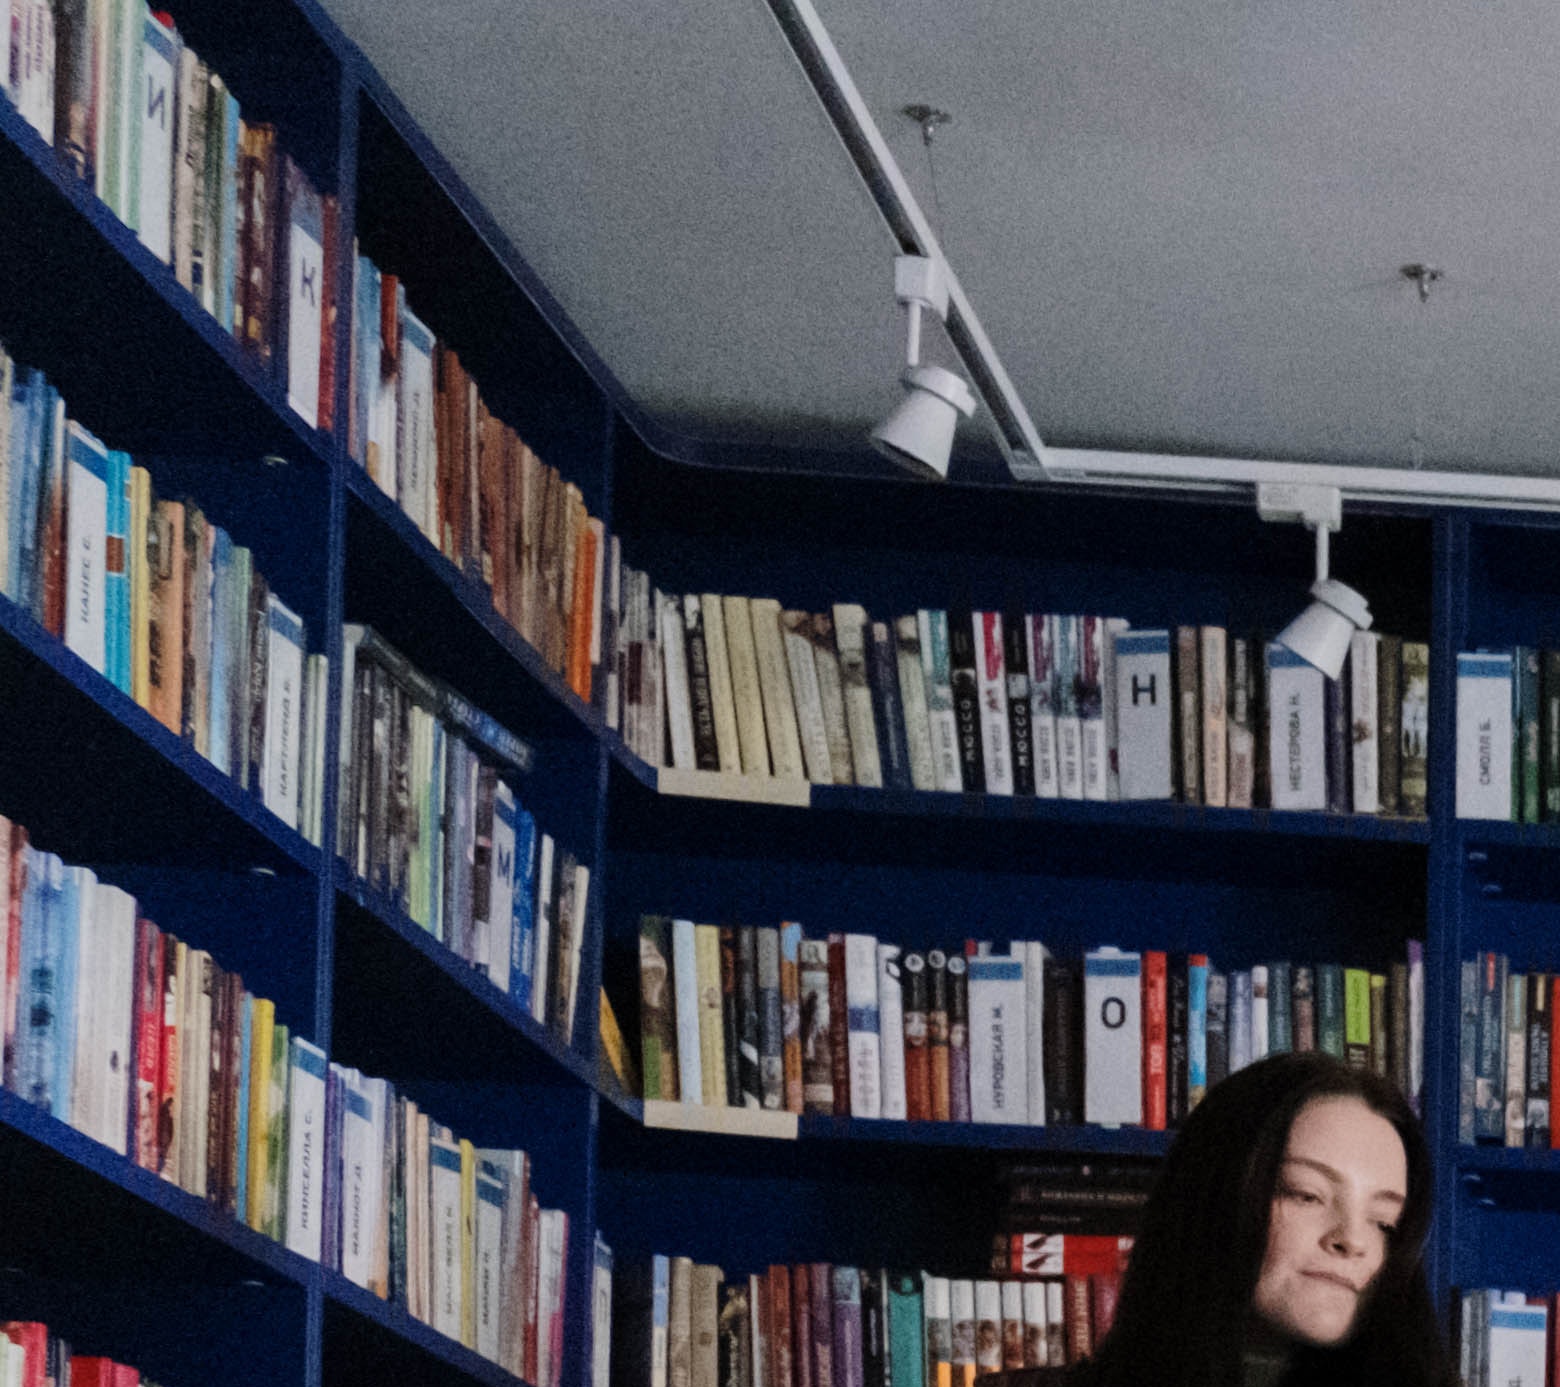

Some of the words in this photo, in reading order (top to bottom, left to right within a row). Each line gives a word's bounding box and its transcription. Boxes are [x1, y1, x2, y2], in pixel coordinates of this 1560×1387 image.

[1131, 675, 1157, 706] Н
[1287, 710, 1302, 792] НЕСТЕРОВА
[1478, 737, 1493, 786] СМОЛЛ
[1100, 996, 1127, 1031] О
